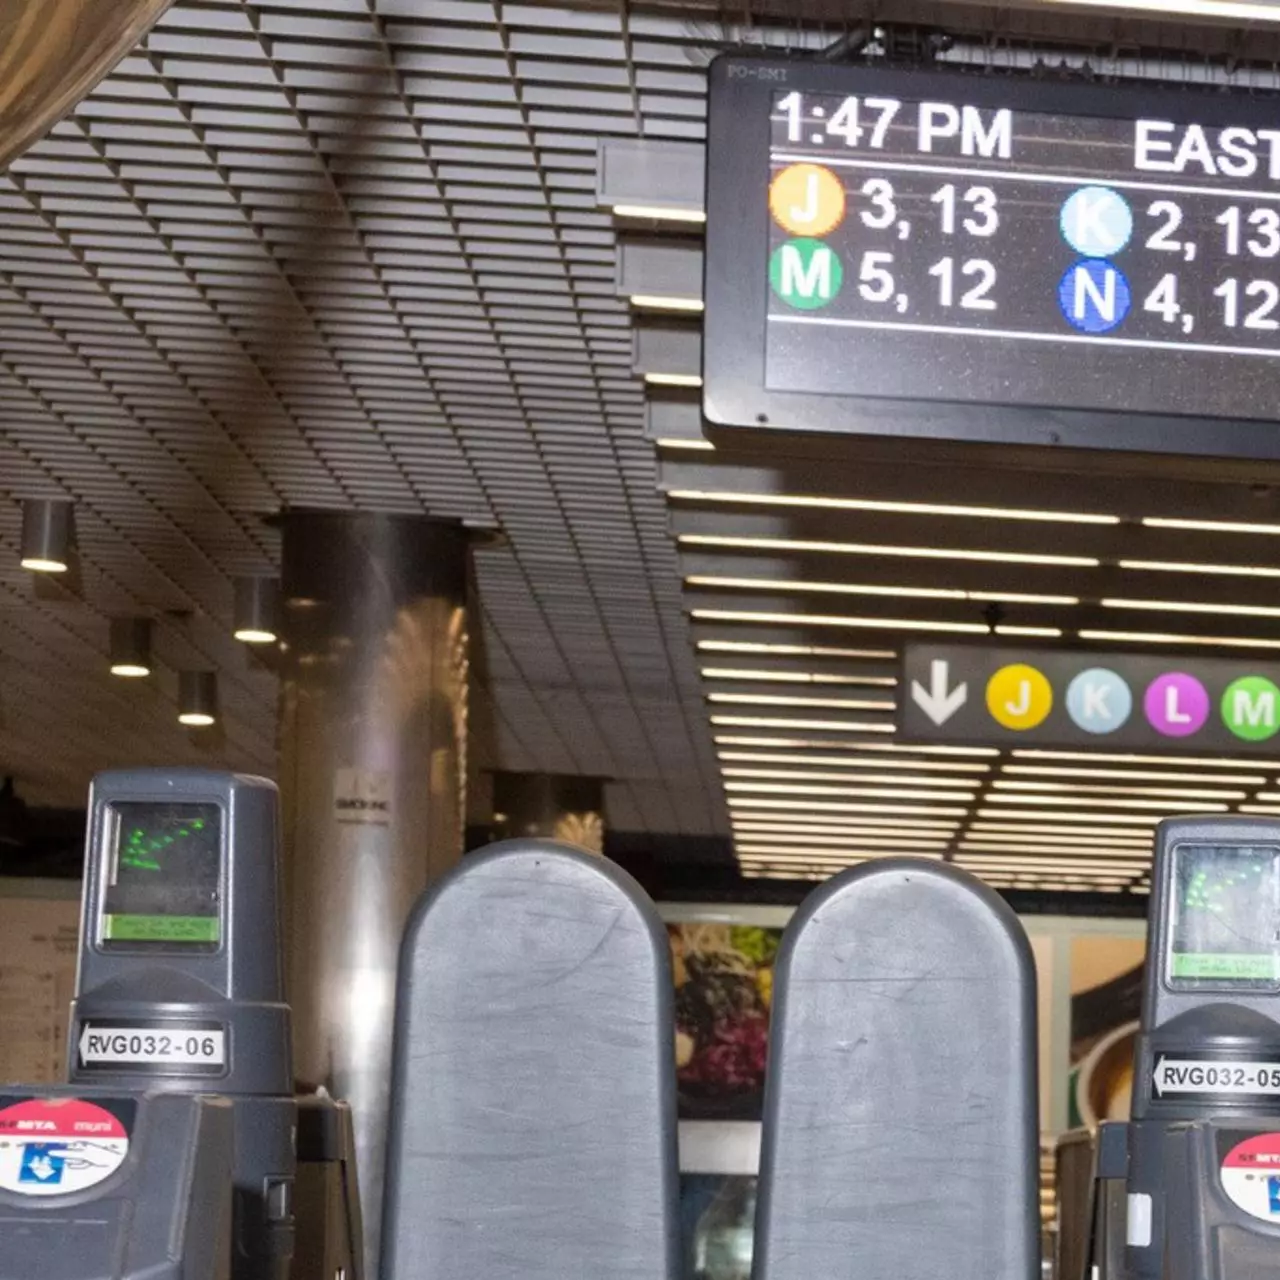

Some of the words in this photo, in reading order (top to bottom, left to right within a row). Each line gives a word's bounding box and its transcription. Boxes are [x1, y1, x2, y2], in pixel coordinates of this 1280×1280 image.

[776, 91, 901, 148] 1:47
[918, 102, 1012, 158] PM
[790, 173, 819, 223] J
[860, 177, 911, 240] 3,
[930, 183, 999, 237] 13
[1077, 192, 1112, 243] K
[1145, 200, 1197, 262] 2,
[779, 244, 832, 300] M
[857, 251, 909, 313] 5,
[928, 256, 998, 310] 12
[1073, 266, 1116, 322] N
[1143, 273, 1194, 334] 4,
[1213, 277, 1280, 330] 12
[1004, 680, 1031, 716] J
[1083, 684, 1111, 719] K
[1165, 685, 1191, 724] L
[1232, 690, 1275, 727] M
[87, 1034, 215, 1057] RVG032-06
